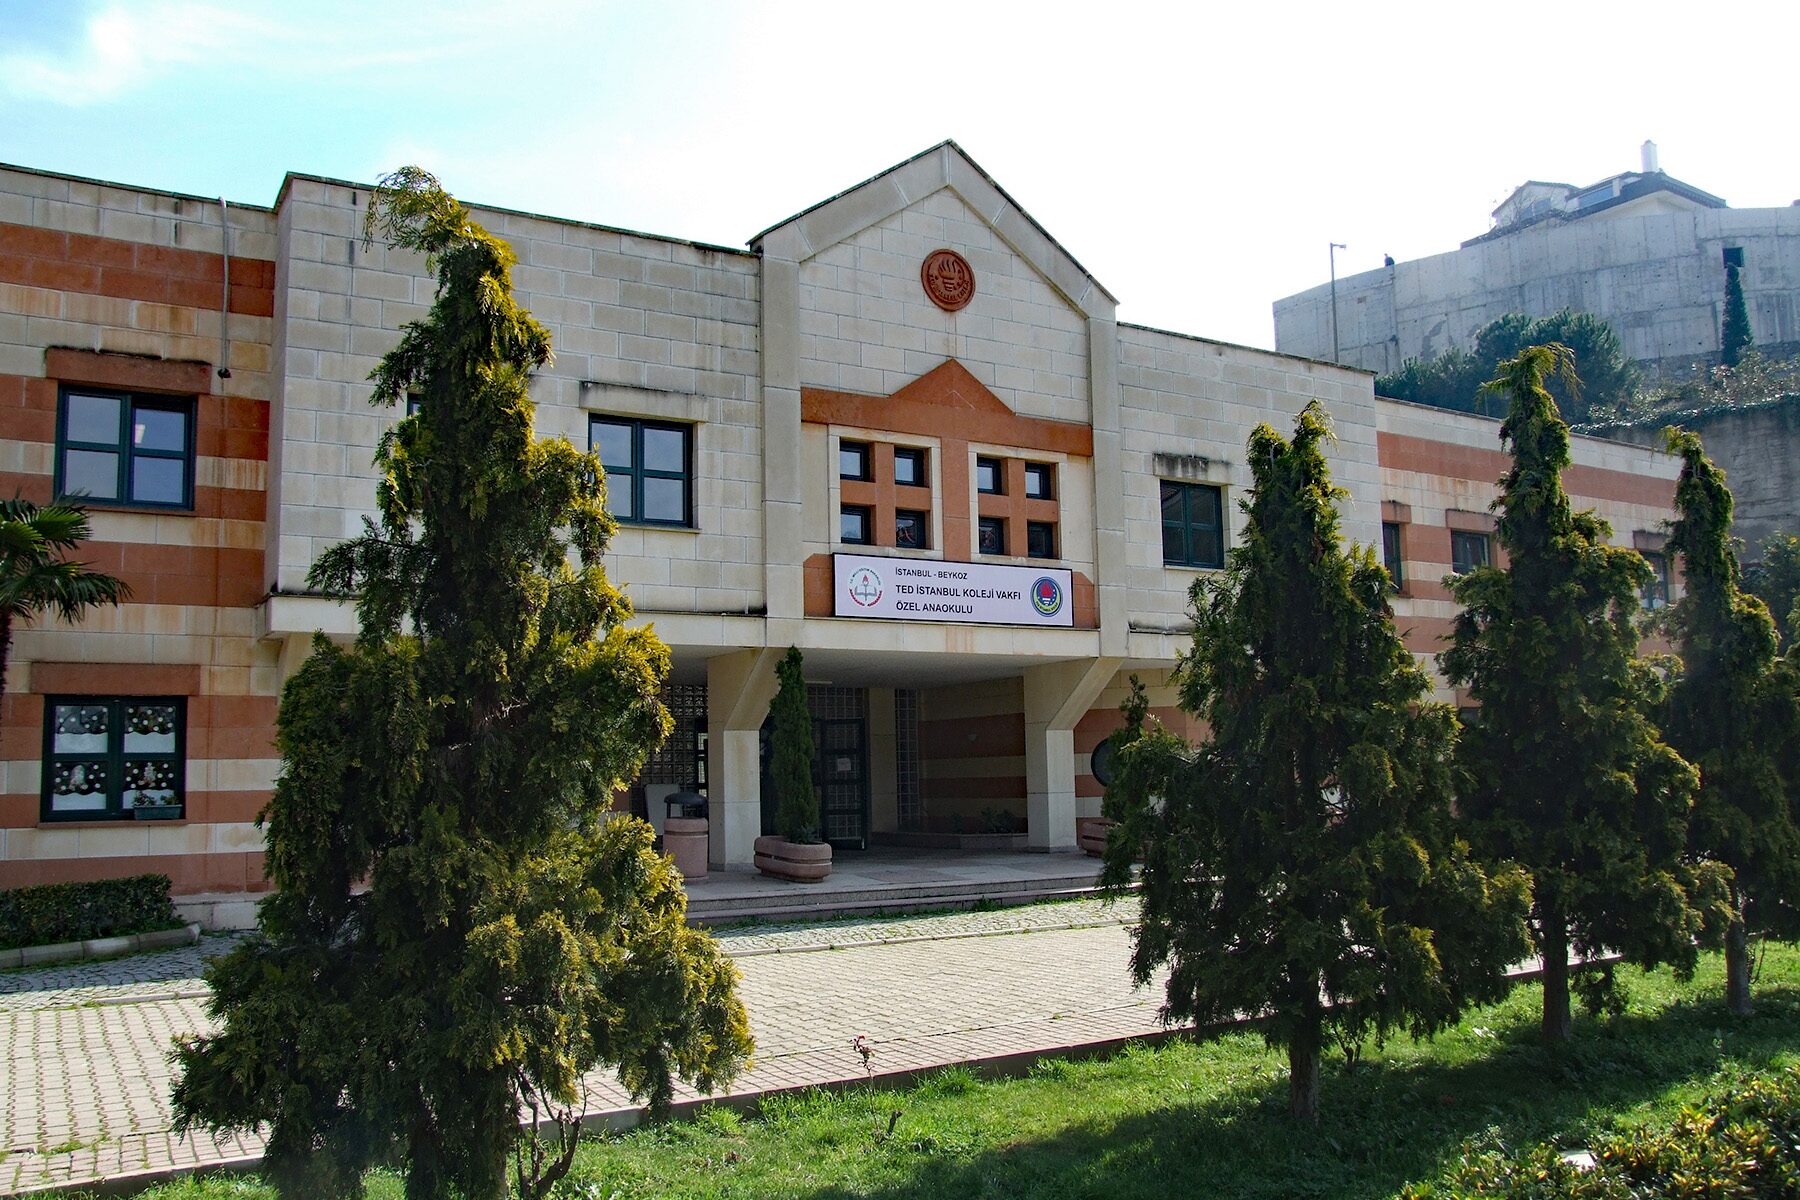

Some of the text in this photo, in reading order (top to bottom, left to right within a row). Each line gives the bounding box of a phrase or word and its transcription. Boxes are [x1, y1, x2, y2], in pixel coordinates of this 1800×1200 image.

[895, 566, 933, 578] İSTANBUL
[937, 571, 968, 580] BEYKOZ
[895, 583, 1021, 600] TED İSTANBUL KOLEJİ VAKFI
[895, 600, 973, 614] ÖZEL ANAOKULU
